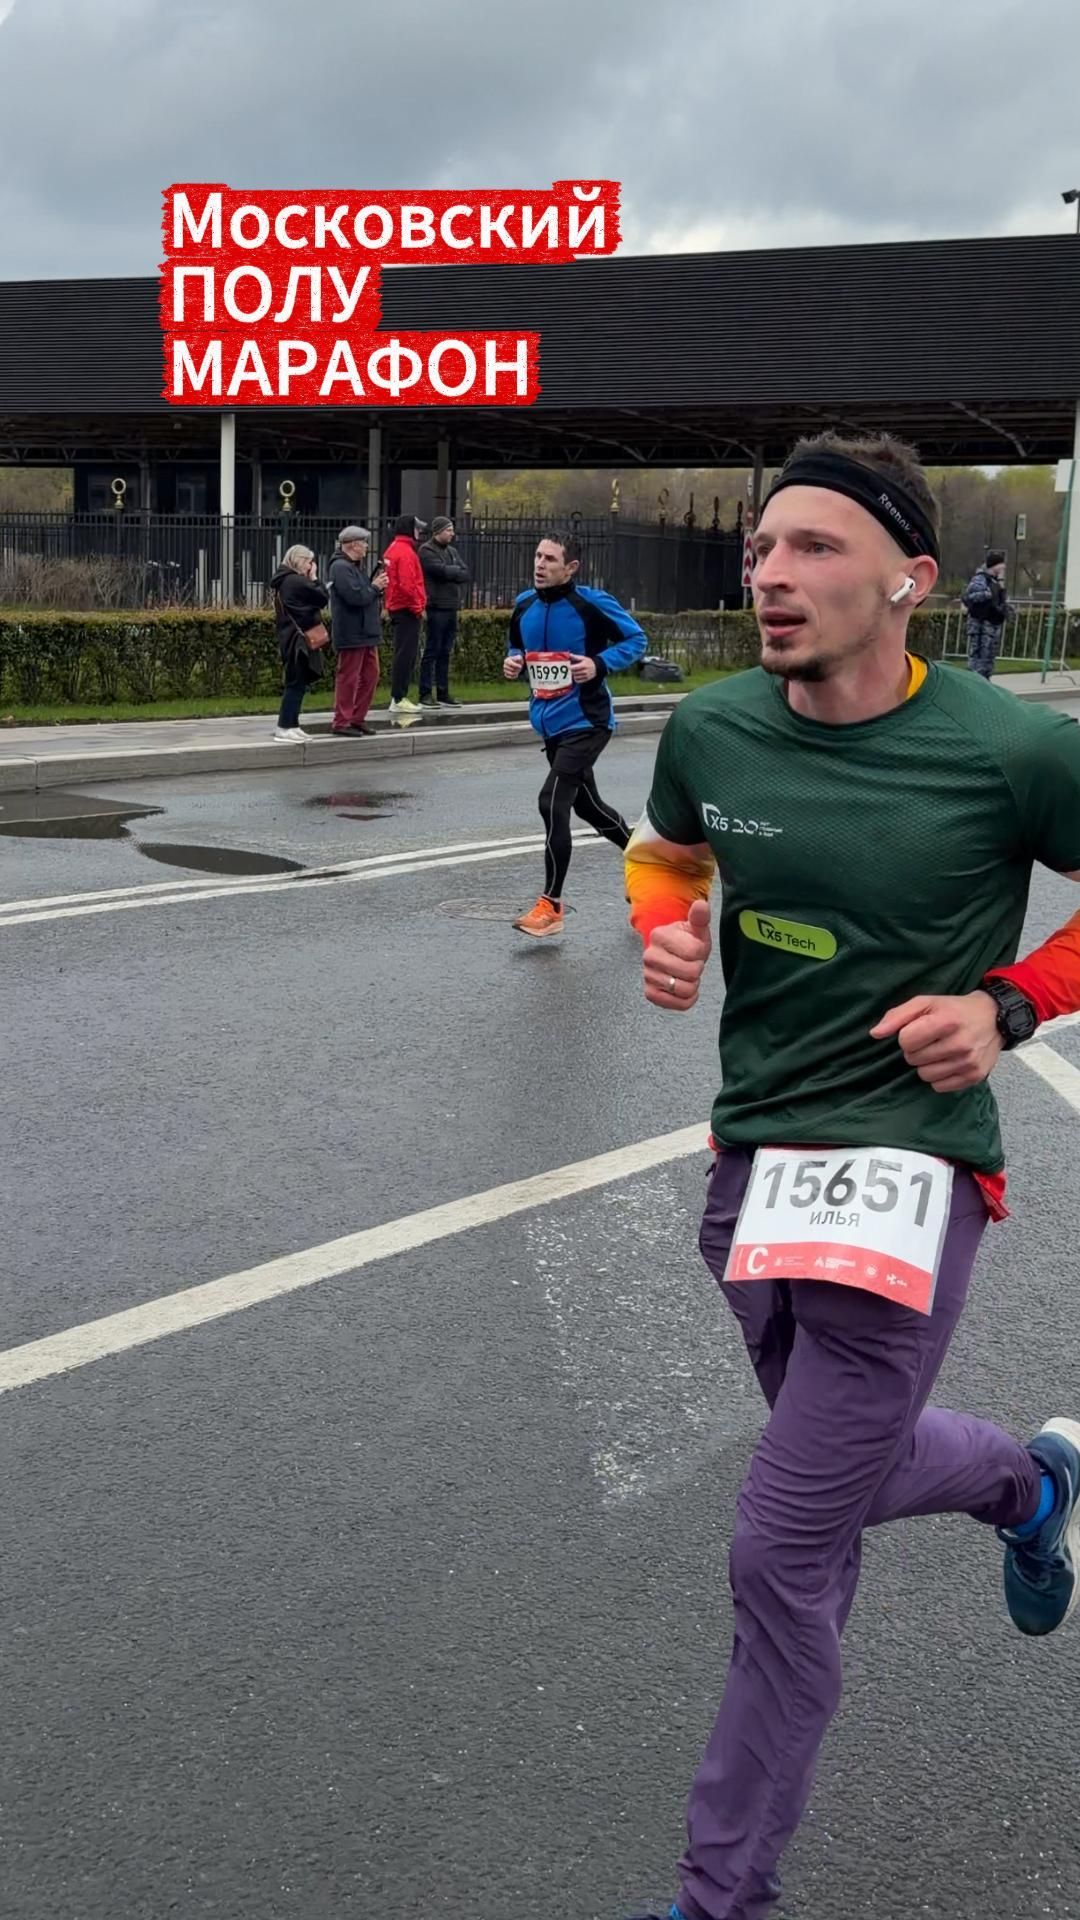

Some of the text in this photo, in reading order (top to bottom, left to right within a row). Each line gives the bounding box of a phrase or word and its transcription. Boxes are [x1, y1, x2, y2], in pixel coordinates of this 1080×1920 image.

[530, 664, 569, 681] 15999
[784, 933, 816, 952] Tech
[762, 1158, 934, 1228] 15651
[809, 1210, 861, 1228] ИЛЬЯ
[746, 1246, 769, 1275] C
